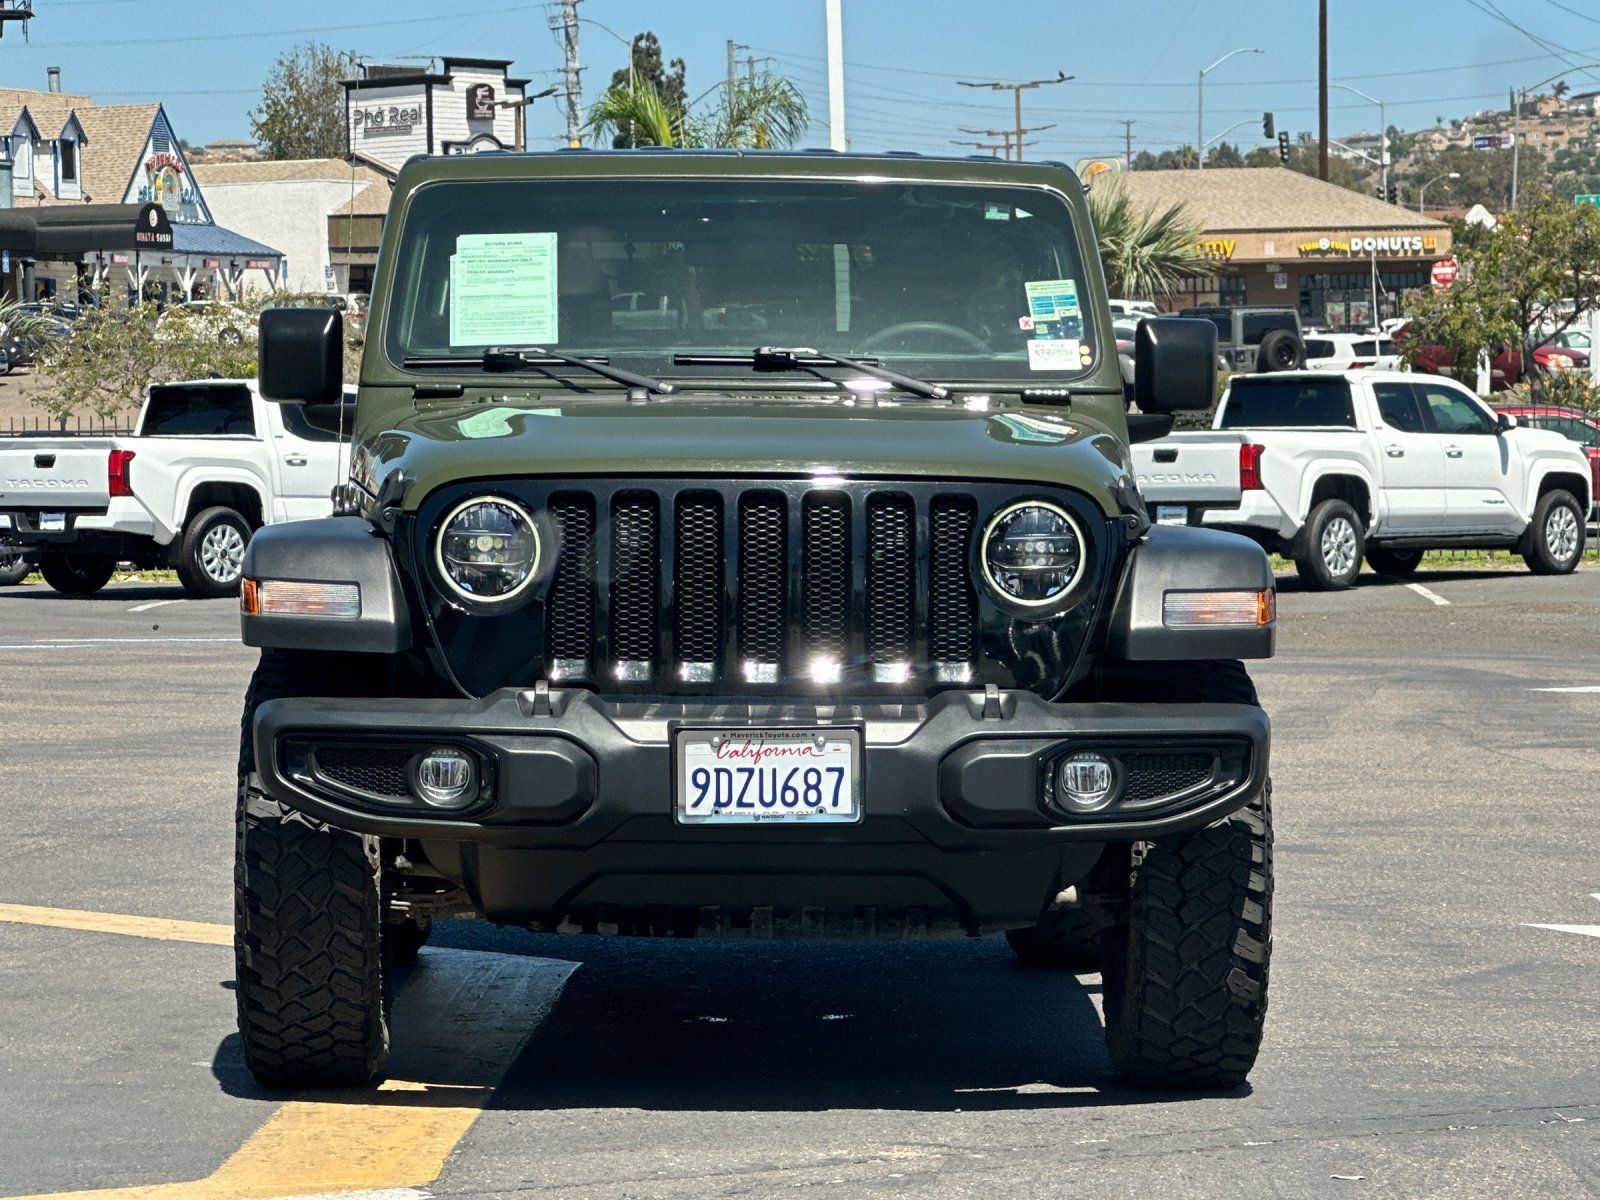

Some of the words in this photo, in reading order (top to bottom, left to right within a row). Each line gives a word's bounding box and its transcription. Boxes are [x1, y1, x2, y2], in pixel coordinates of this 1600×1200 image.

[389, 103, 423, 125] Real
[1350, 236, 1423, 251] DONUTS
[5, 478, 89, 489] TACOMA
[716, 739, 825, 765] California
[691, 766, 846, 809] 9DZU687
